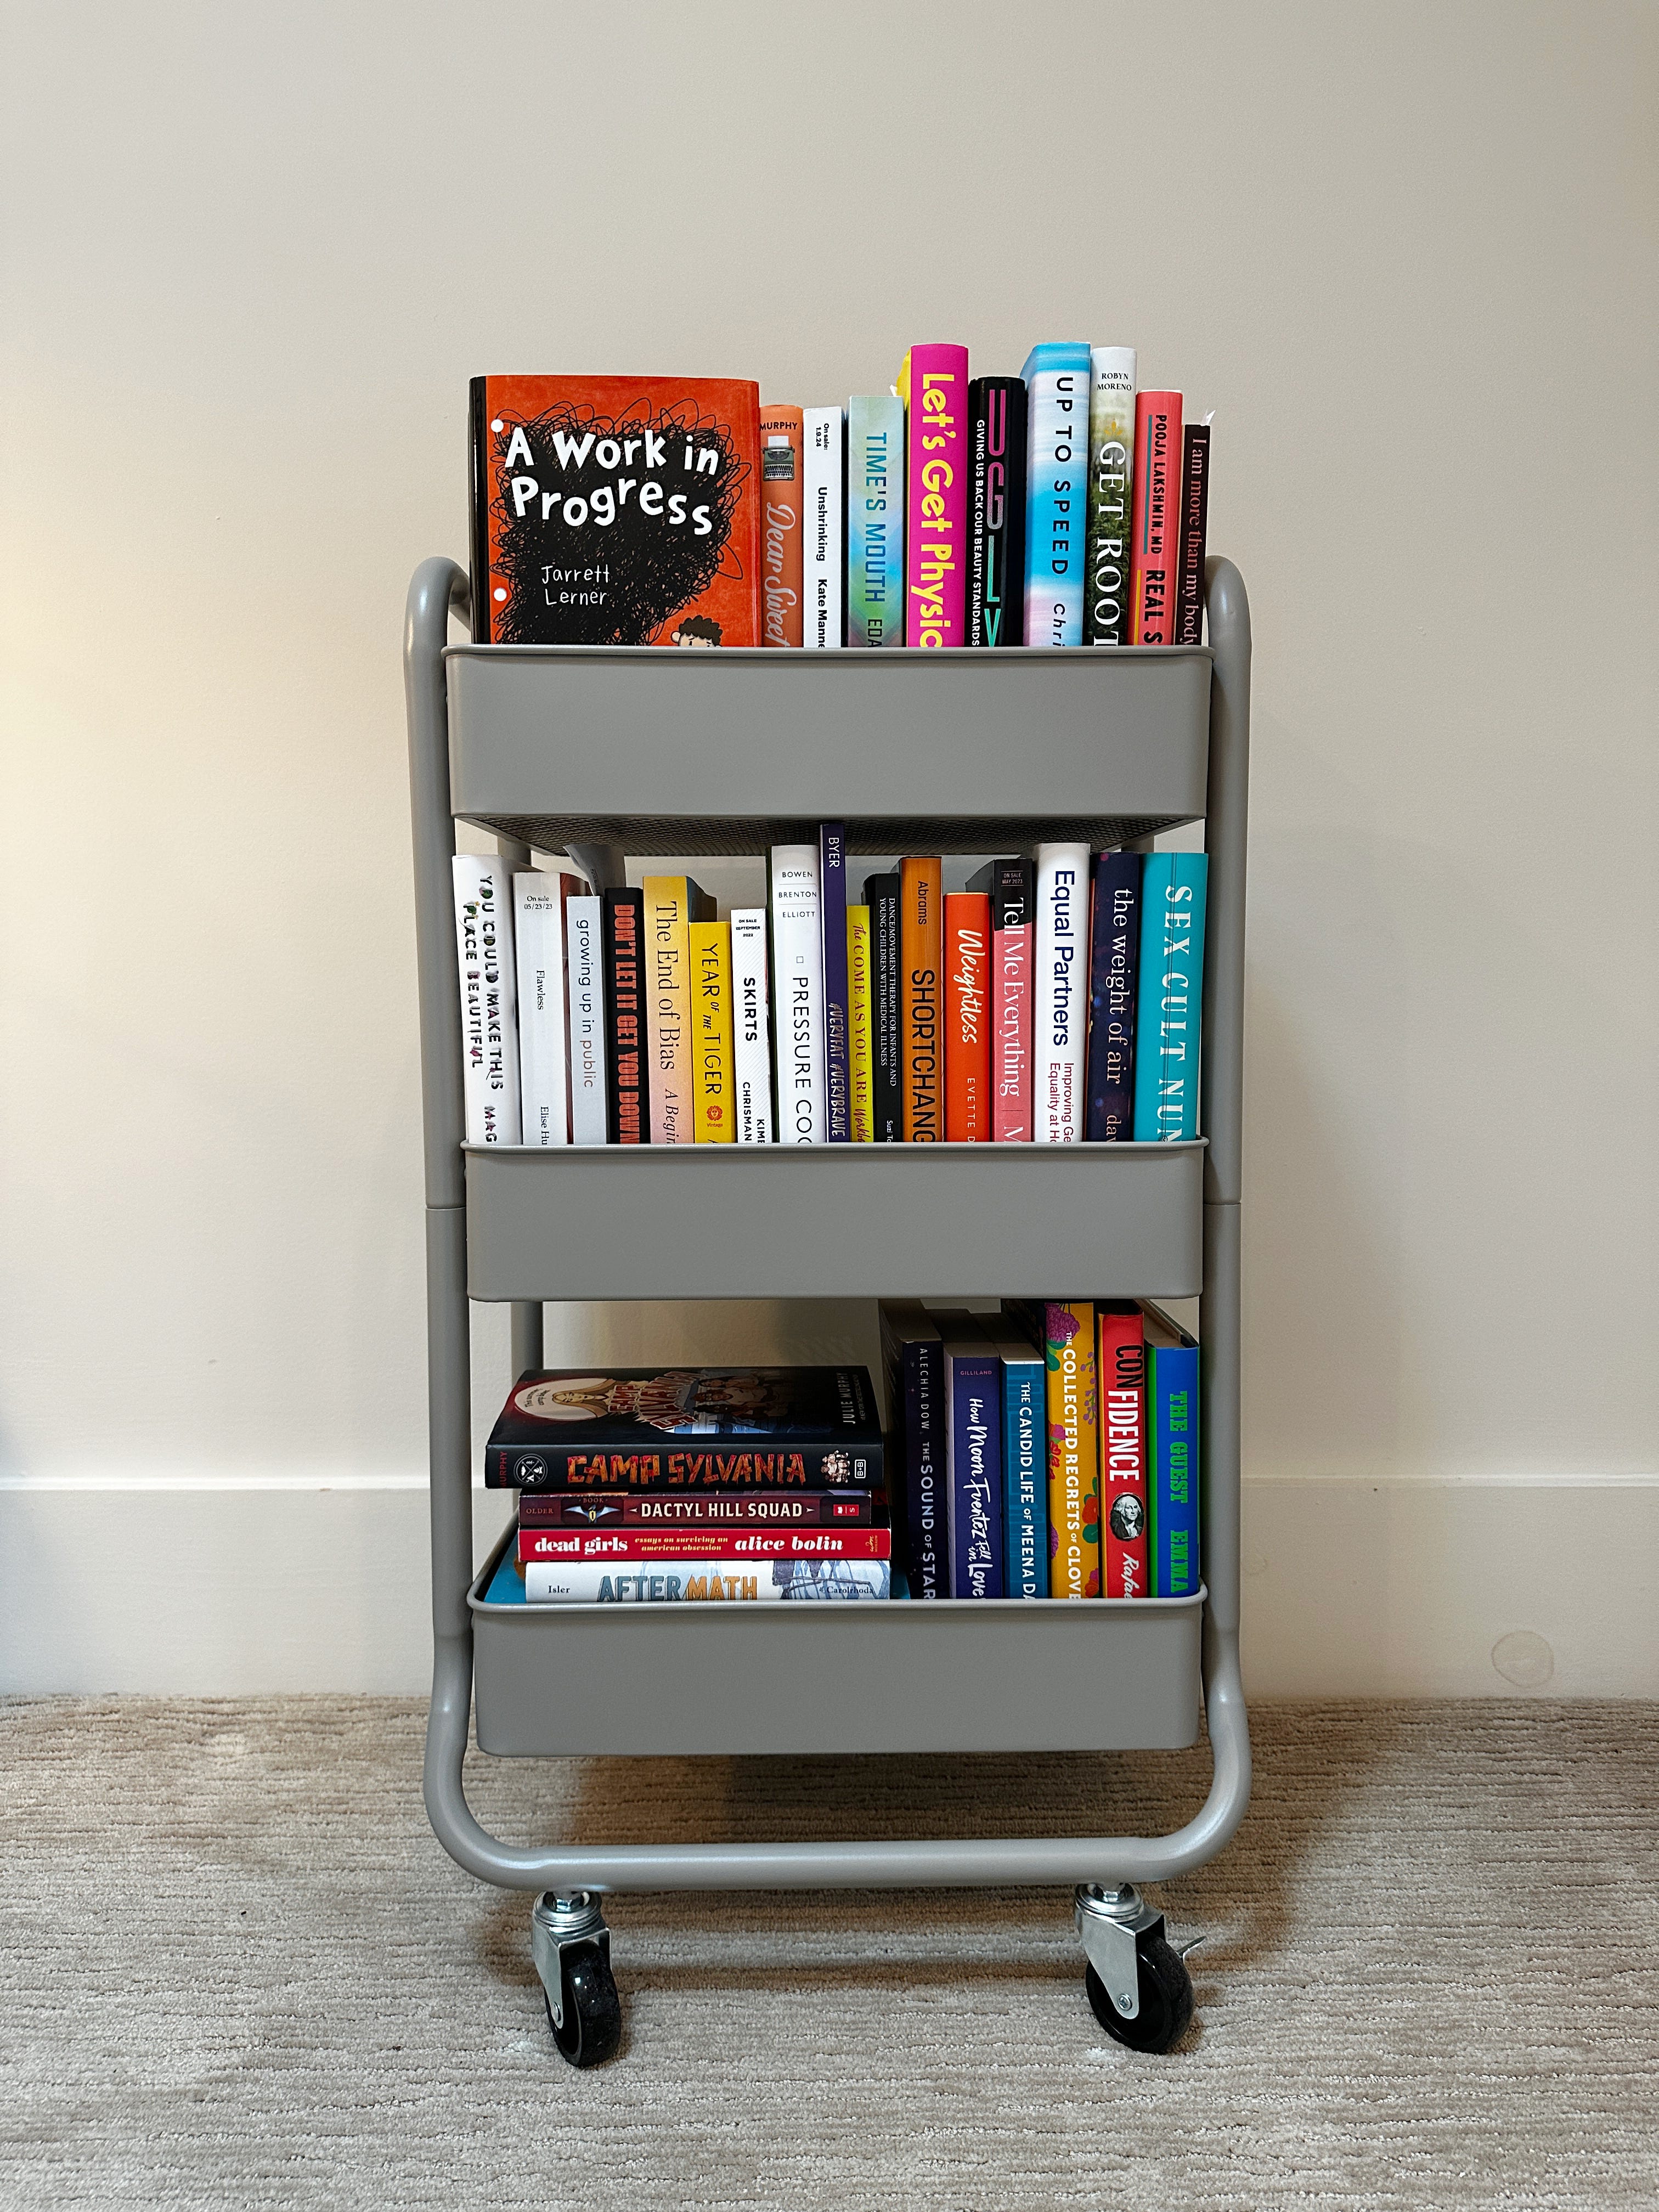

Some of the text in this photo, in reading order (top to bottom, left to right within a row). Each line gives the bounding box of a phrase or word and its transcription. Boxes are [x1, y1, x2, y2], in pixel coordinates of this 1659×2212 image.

[1097, 382, 1132, 391] MORENO
[505, 427, 719, 475] A Work in
[759, 422, 798, 431] MURPHY
[976, 420, 985, 461] GIVING
[975, 463, 984, 477] US
[1052, 377, 1073, 575] UP TO SPEED
[1098, 441, 1126, 520] GET
[1192, 448, 1203, 476] am
[511, 476, 712, 535] Progress
[865, 432, 887, 602] TIME'S MOUTH
[911, 374, 956, 647] Let's Get Physic
[975, 479, 984, 509] BACK
[1189, 481, 1202, 525] more
[766, 502, 796, 574] Dear
[816, 487, 827, 561] Unshrinking
[974, 511, 983, 537] OUR
[1187, 529, 1200, 569] than
[541, 564, 610, 584] Jarrett
[974, 538, 982, 580] BEAUTY
[545, 589, 607, 605] Lerner
[817, 579, 827, 607] Kate
[1144, 571, 1165, 622] REAL
[1181, 574, 1197, 601] my
[1180, 605, 1199, 645] body
[827, 837, 840, 868] BYER
[917, 881, 928, 926] Abrams
[464, 904, 479, 960] PLACE
[888, 898, 896, 975] DANCE/MOVEMENT
[479, 876, 504, 1090] YOU COULD MAKE THIS
[1050, 871, 1074, 1046] Equal Partners
[1159, 885, 1192, 1061] SEX CULT
[536, 970, 545, 1010] Flawless
[576, 919, 596, 1087] growing up in public
[656, 901, 680, 1070] The End of Bias
[744, 977, 757, 1041] SKIRTS
[953, 929, 985, 1044] Weightless
[999, 898, 1024, 1097] Tell Me Everything
[1105, 888, 1132, 1084] the weight of air
[614, 904, 640, 1143] DON'T LET IT GET YOU DOWN
[701, 943, 722, 1094] YEAR THE TIGER
[792, 977, 811, 1089] PRESSURE
[852, 922, 867, 1104] The COME AS YOU ARE
[967, 1077, 975, 1128] EVETTE
[1048, 1063, 1060, 1127] Equality at
[1061, 1063, 1074, 1122] Improving
[919, 1349, 928, 1399] ALECHIA
[1063, 1348, 1077, 1449] COLLECTED
[969, 1399, 983, 1423] How
[567, 1452, 806, 1485] CAMP SYLVANIA
[967, 1427, 988, 1477] Moon
[1169, 1391, 1188, 1503] THE GUEST
[921, 1465, 933, 1530] SOUND
[1019, 1382, 1034, 1578] THE CANDID LIFE OF MEENA
[1065, 1454, 1080, 1530] REGRETS
[641, 1503, 803, 1517] DACTYL HILL SQUAD
[535, 1537, 628, 1555] dead girls
[735, 1536, 843, 1551] alice bolin
[924, 1536, 932, 1549] OF
[979, 1539, 991, 1560] Fell
[1071, 1533, 1076, 1543] OF
[1170, 1530, 1188, 1593] EMMA
[967, 1547, 992, 1596] in Love
